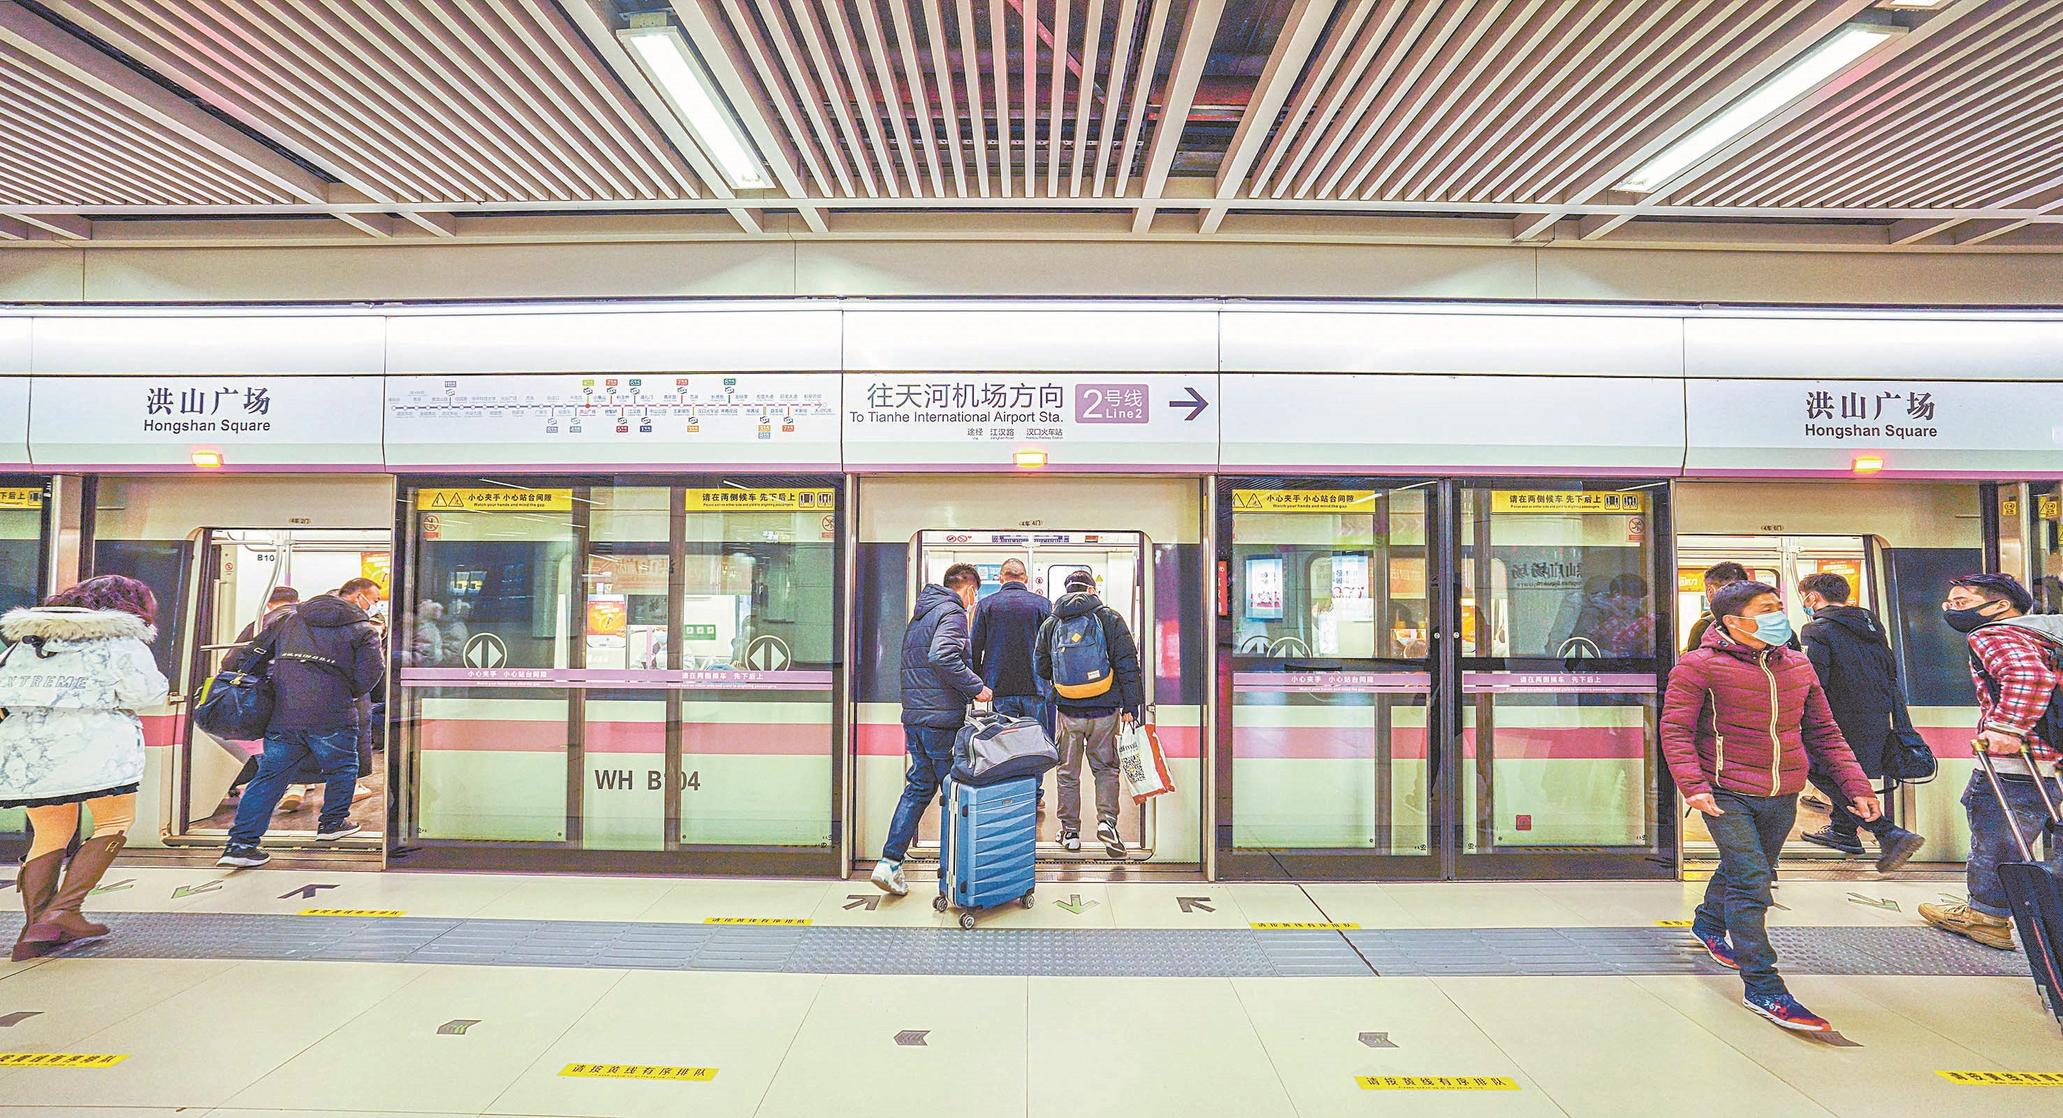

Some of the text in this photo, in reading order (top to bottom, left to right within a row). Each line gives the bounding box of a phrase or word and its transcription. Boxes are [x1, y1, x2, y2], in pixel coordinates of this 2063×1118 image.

[146, 386, 271, 416] 洪山广场
[868, 382, 1064, 409] 往天河机场方向
[1805, 391, 1936, 421] 洪山广场
[850, 411, 1064, 425] To Tianhe International Airport Sta.
[144, 419, 271, 436] Hongshan Square
[967, 428, 1063, 437] 途经 江汉路 汉口火车站
[1805, 424, 1938, 440] Hongshan Square
[467, 493, 501, 502] 小心夹手
[702, 492, 757, 502] 请在两侧候车
[1266, 494, 1300, 503] 小心夹手
[1509, 494, 1601, 503] 请在两侧候车 先下后上
[594, 769, 633, 790] WH
[572, 1064, 706, 1077] 请按黄线有序排队
